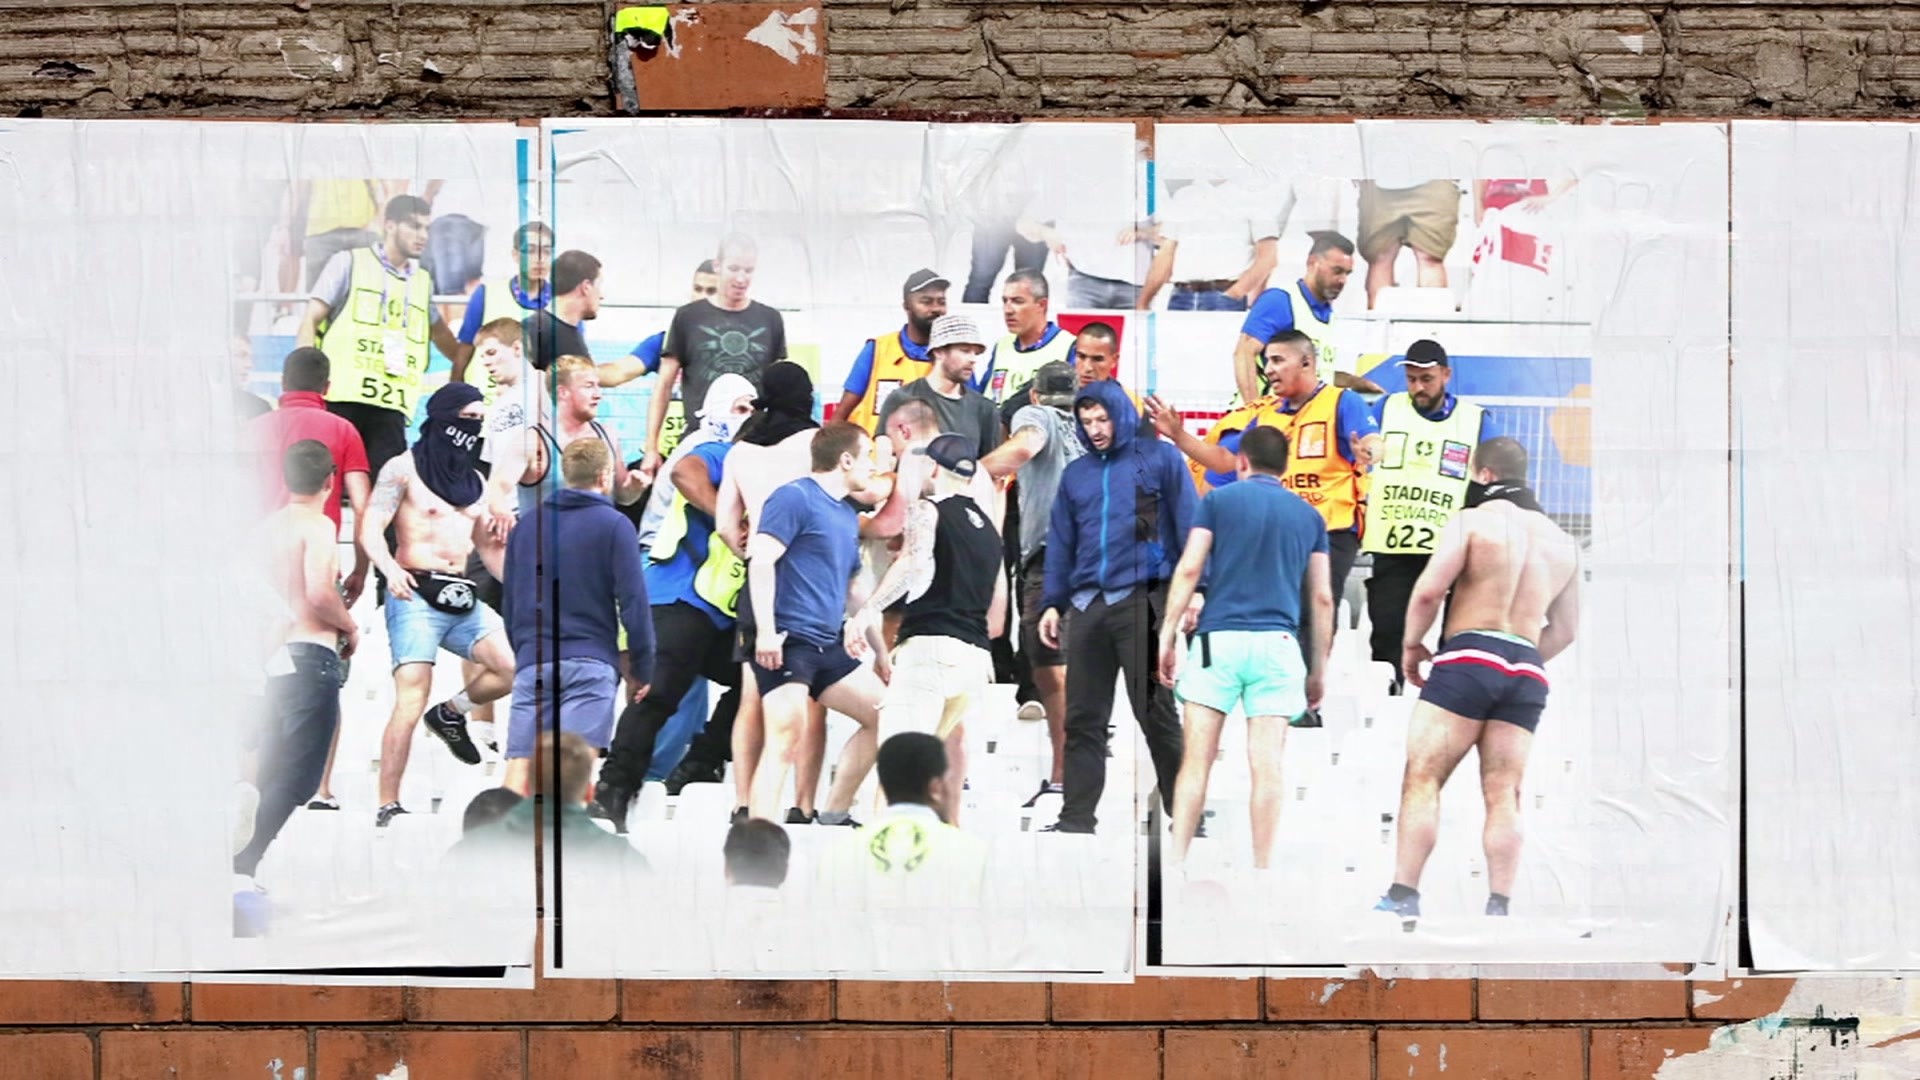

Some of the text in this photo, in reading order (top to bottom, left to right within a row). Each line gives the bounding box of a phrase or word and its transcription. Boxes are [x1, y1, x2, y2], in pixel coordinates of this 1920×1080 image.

[361, 377, 408, 409] 521
[1281, 473, 1321, 489] DIER
[1383, 485, 1453, 509] STADIER
[1381, 504, 1449, 528] STEWARD
[1386, 525, 1435, 551] 622
